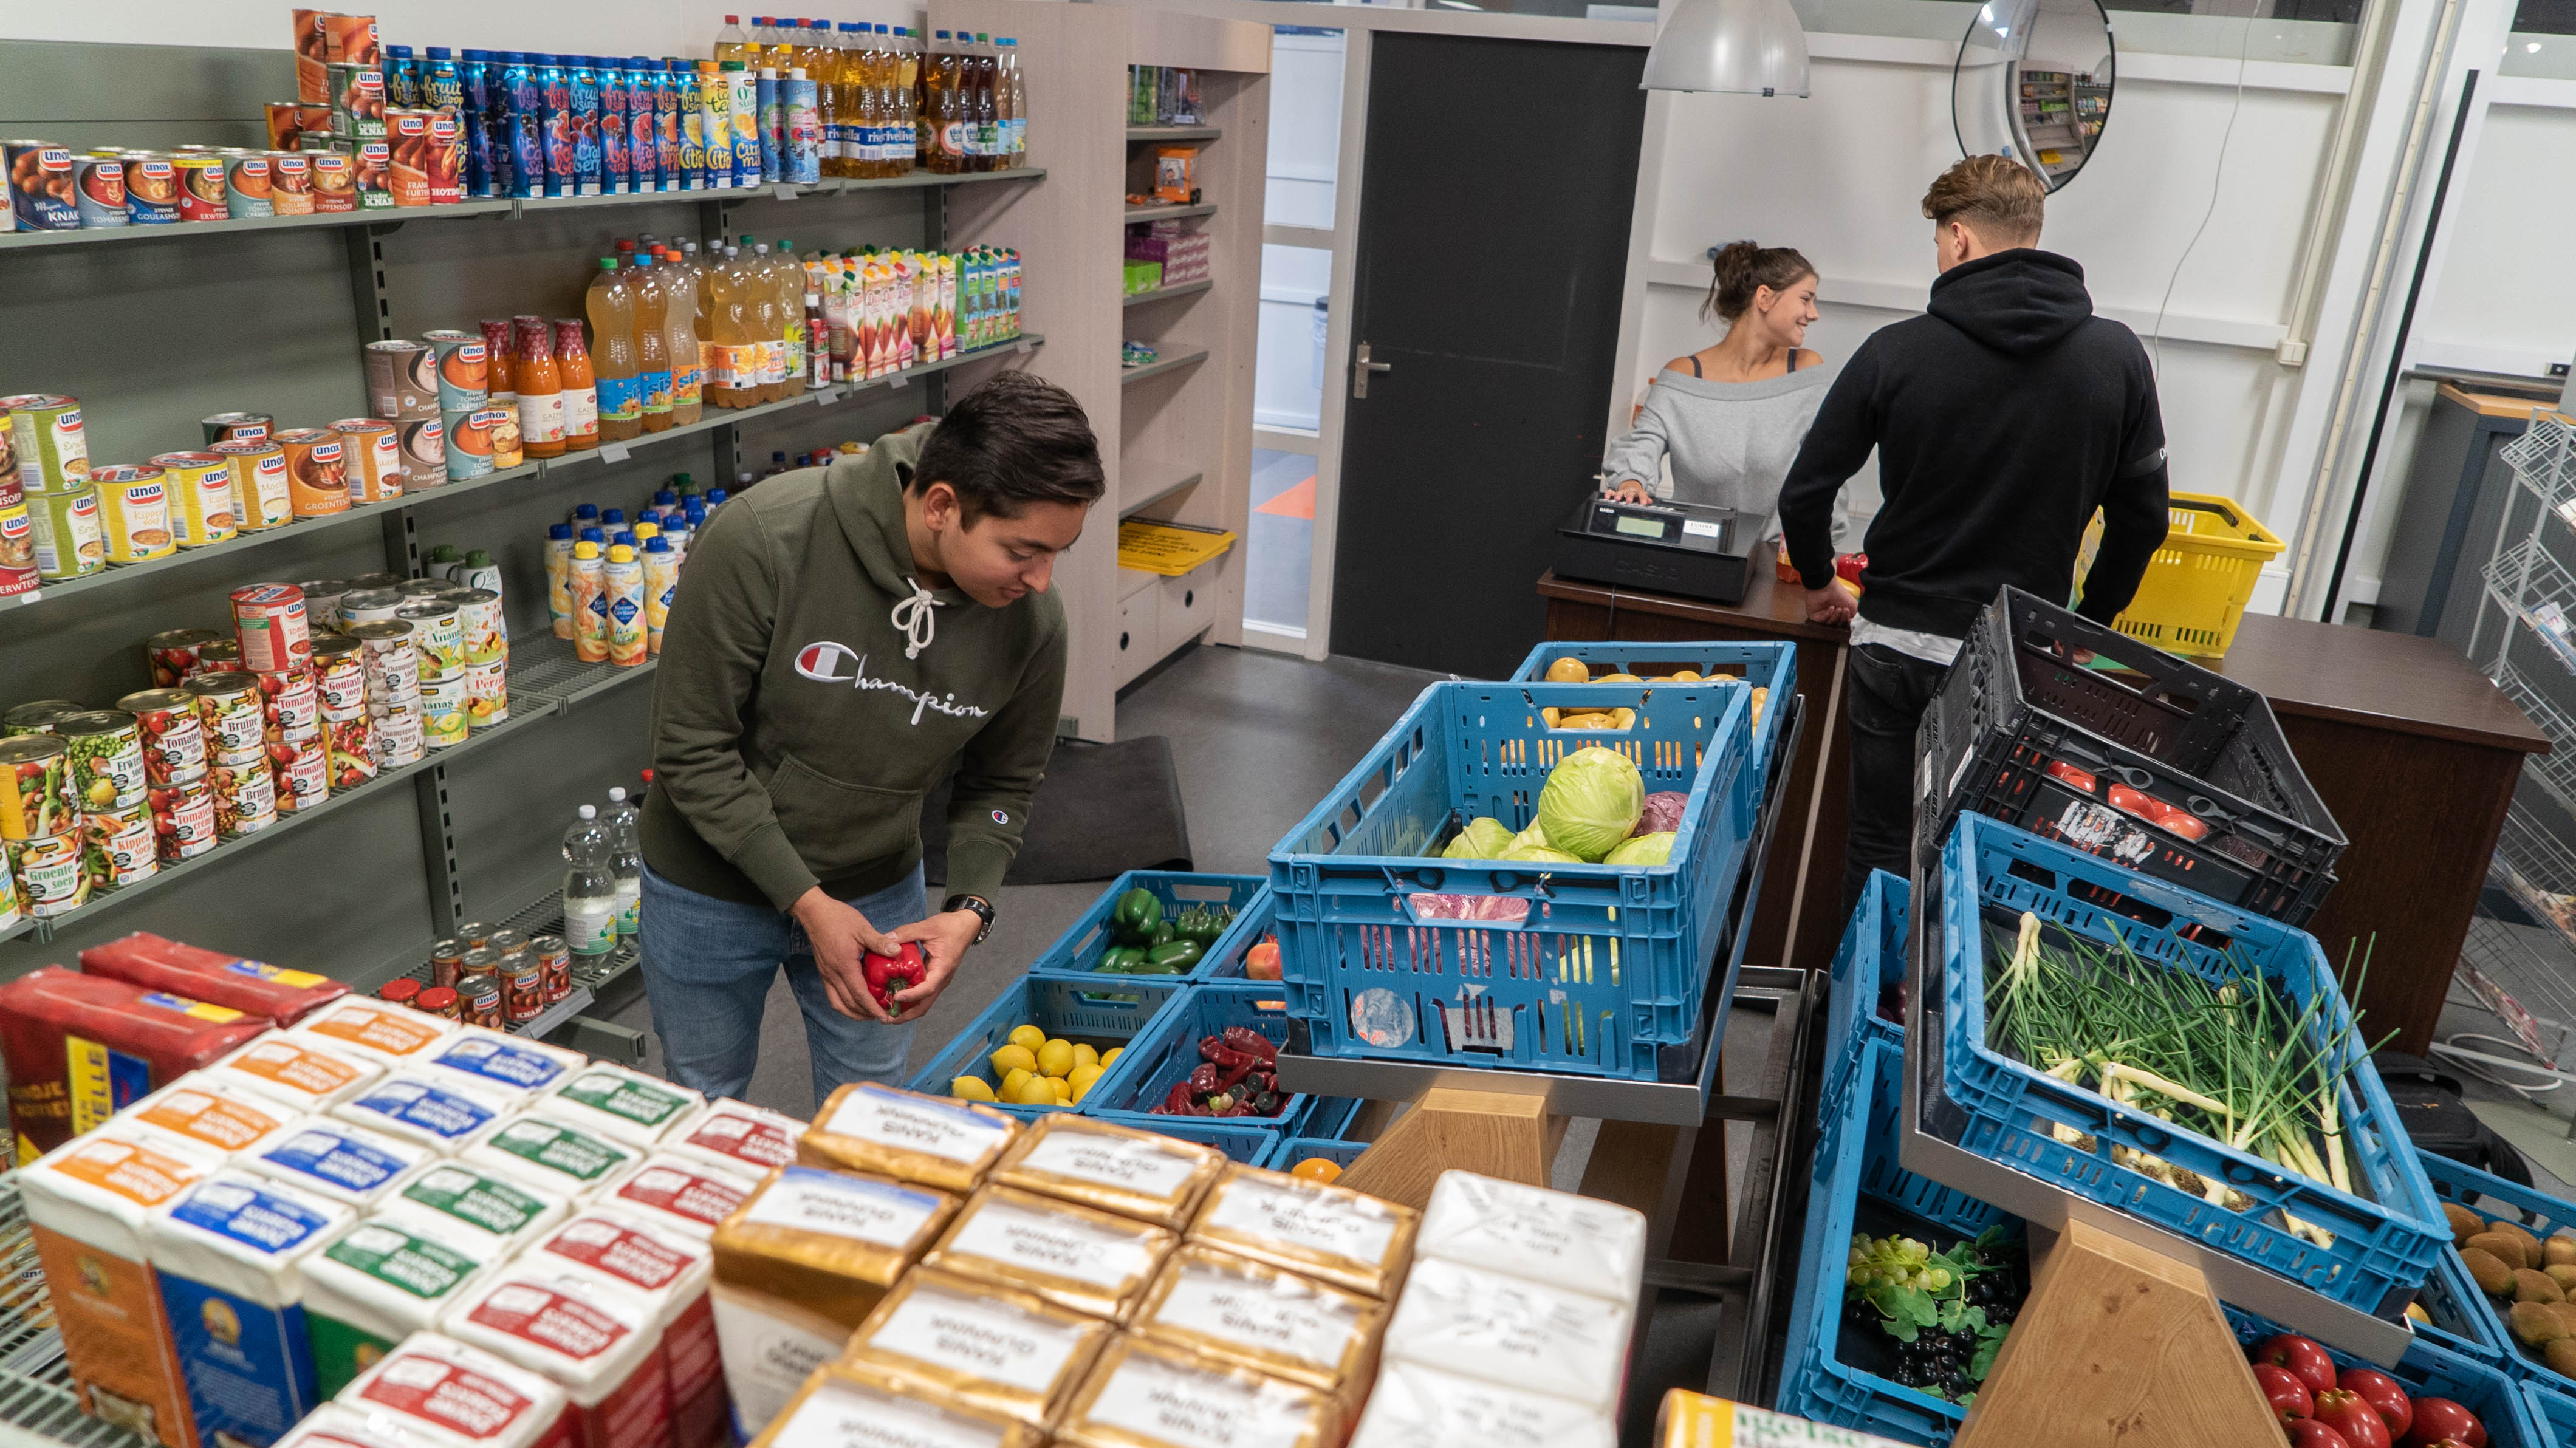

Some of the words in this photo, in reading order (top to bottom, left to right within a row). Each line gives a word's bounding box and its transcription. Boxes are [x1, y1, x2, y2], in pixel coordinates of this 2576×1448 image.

[238, 428, 264, 437] unox
[316, 445, 340, 455] unox
[130, 485, 162, 497] unox
[329, 675, 361, 692] Goulash
[345, 686, 361, 697] soep
[795, 641, 988, 725] Champion
[117, 834, 150, 852] Kippen
[135, 844, 151, 856] soep
[30, 863, 74, 881] Groente
[52, 875, 74, 889] soep
[883, 1122, 939, 1144] KANIS
[805, 1208, 866, 1227] KANIS
[937, 1337, 1005, 1368] KANIS
